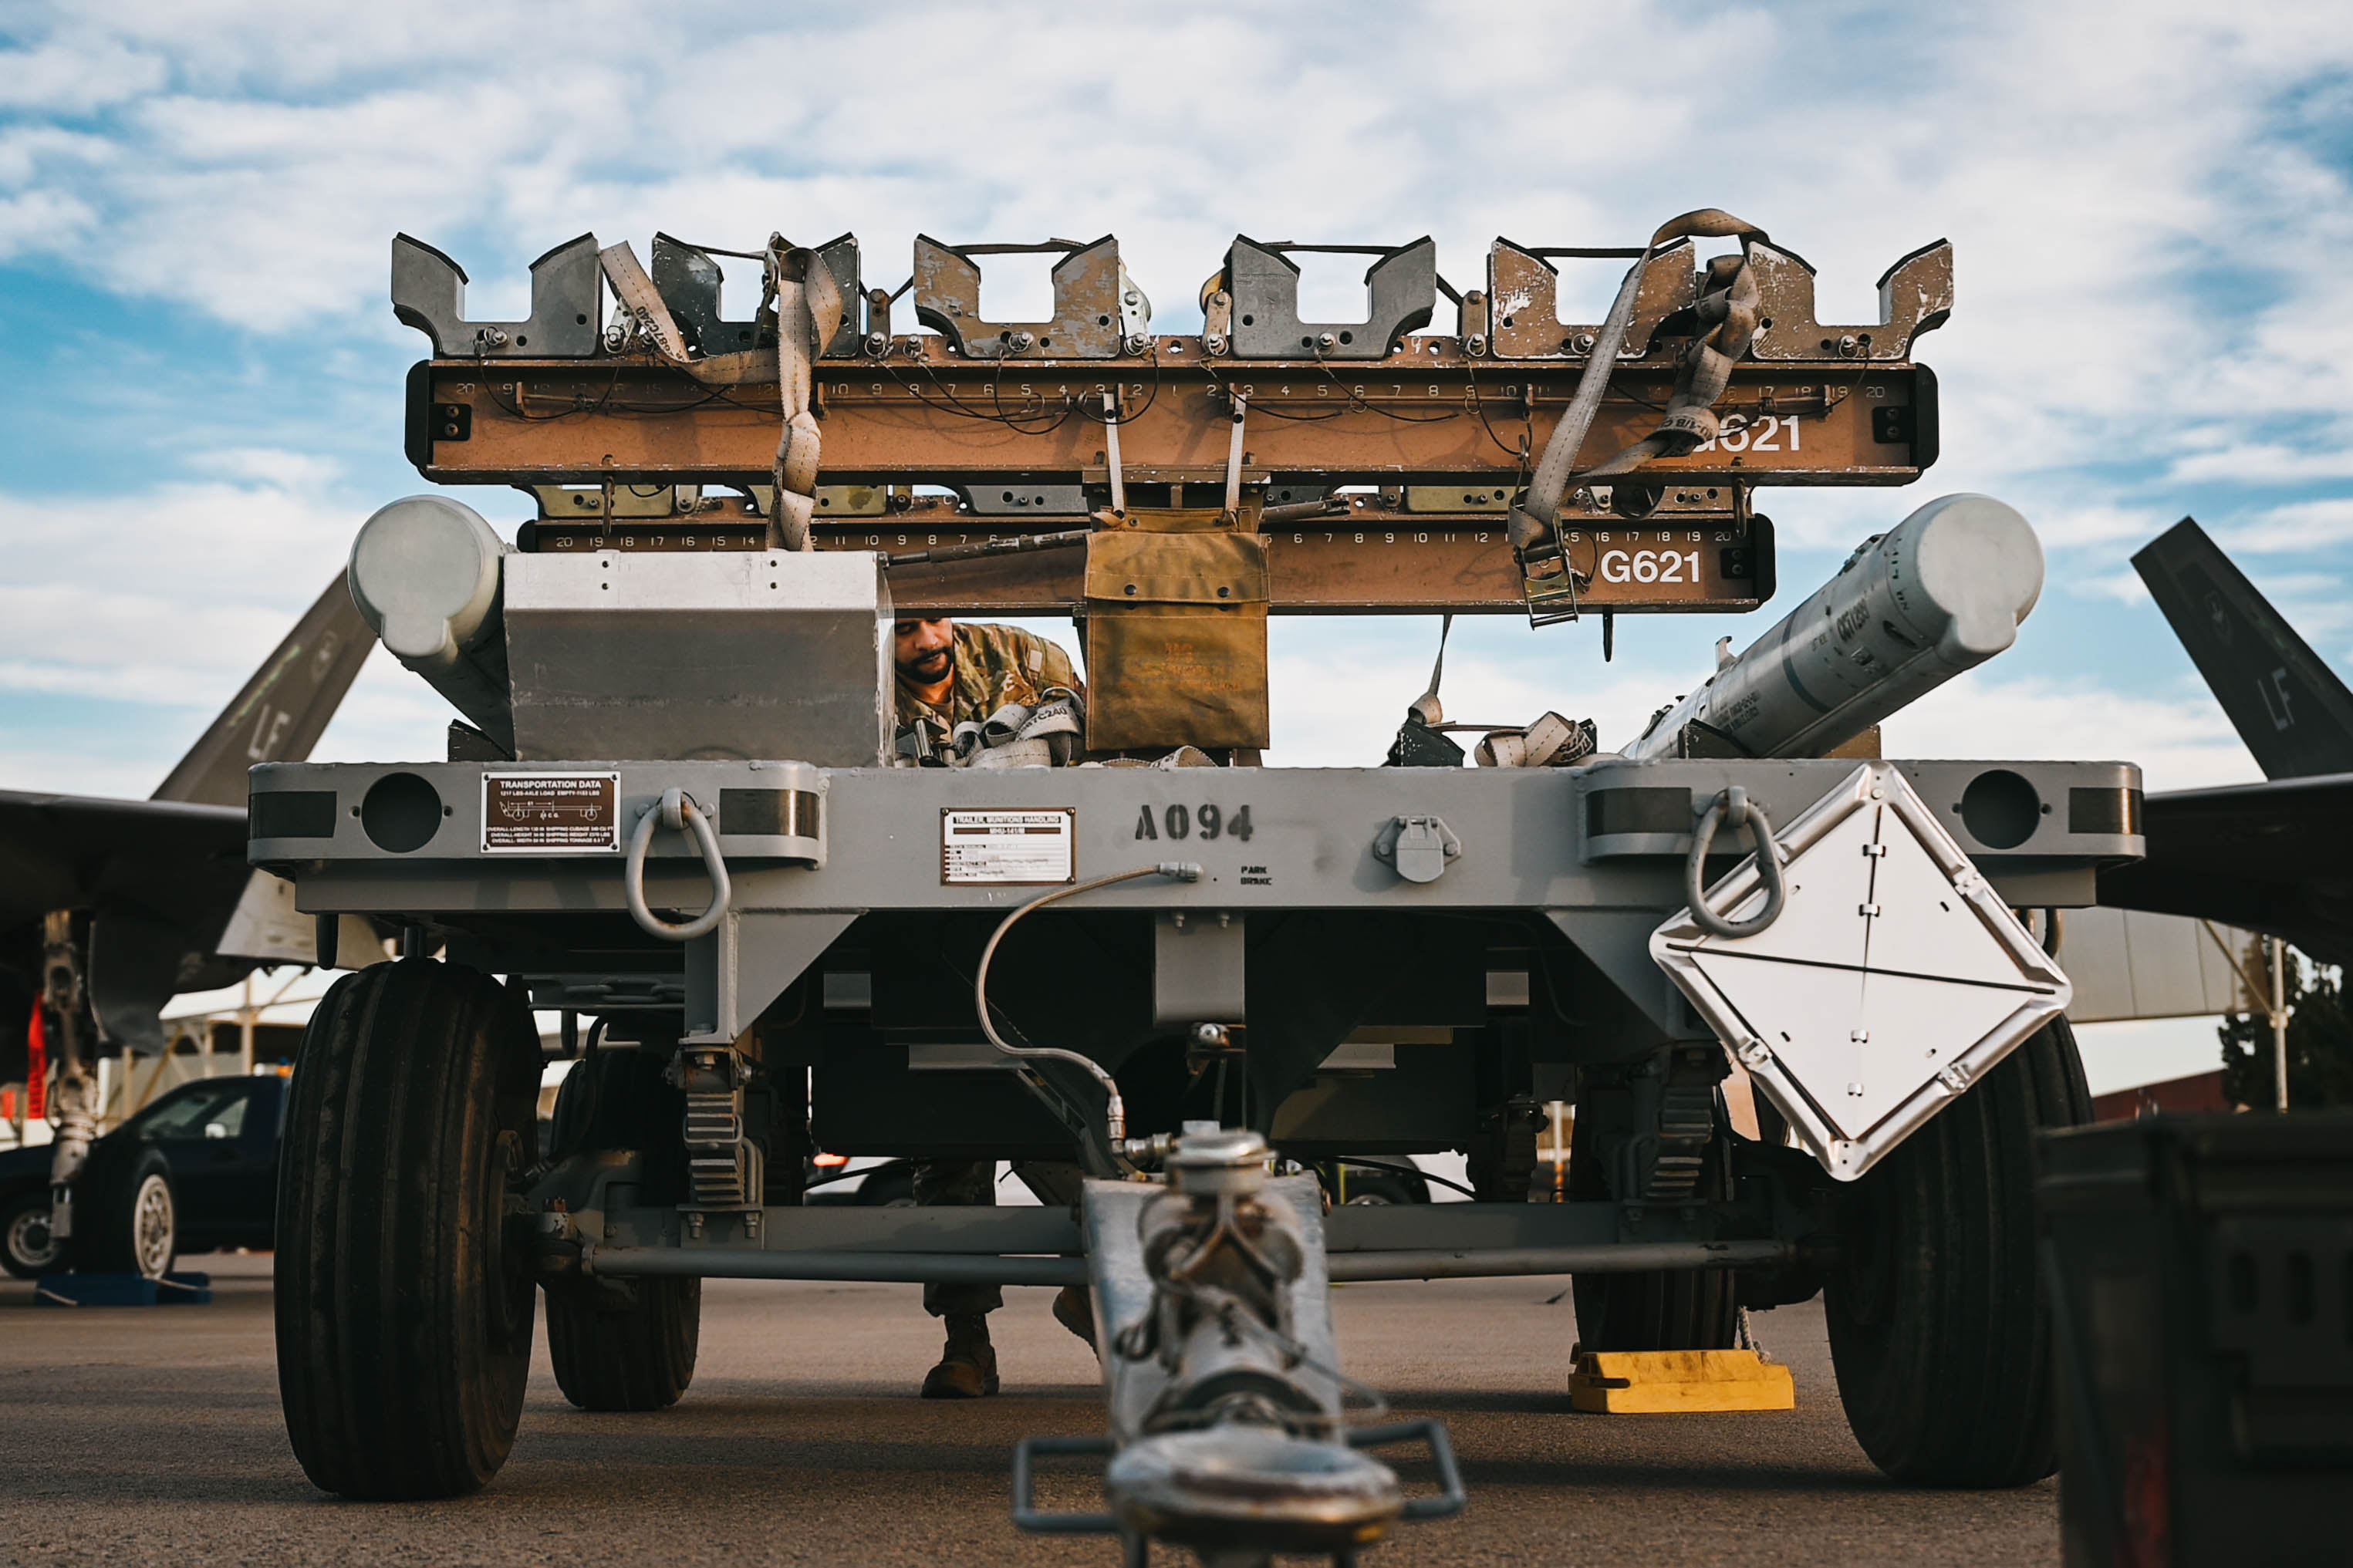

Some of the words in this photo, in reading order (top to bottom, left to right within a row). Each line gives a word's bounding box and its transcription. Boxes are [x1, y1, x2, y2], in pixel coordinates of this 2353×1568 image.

[456, 383, 475, 395] 20
[832, 383, 849, 395] 10
[872, 384, 883, 395] 9
[947, 384, 957, 395] 7
[984, 384, 994, 395] 6
[1021, 384, 1031, 395] 5
[1058, 385, 1068, 395] 4
[1095, 384, 1106, 395] 3
[1133, 385, 1143, 396] 2
[1206, 385, 1217, 396] 2
[1243, 385, 1254, 396] 3
[1281, 385, 1290, 396] 4
[1317, 385, 1328, 396] 5
[1354, 385, 1365, 396] 6
[1392, 385, 1402, 396] 7
[1428, 385, 1440, 396] 8
[1501, 385, 1517, 396] 10
[1758, 386, 1774, 397] 17
[1795, 386, 1811, 397] 18
[1831, 386, 1848, 397] 19
[1865, 386, 1885, 398] 20
[1692, 414, 1801, 453] 621
[556, 537, 573, 548] 20
[589, 537, 604, 547] 19
[620, 537, 634, 547] 18
[650, 537, 664, 547] 17
[681, 537, 696, 546] 16
[712, 536, 726, 546] 15
[743, 536, 755, 546] 14
[836, 535, 846, 545] 11
[865, 534, 879, 545] 10
[898, 534, 906, 545] 9
[928, 534, 937, 545] 8
[960, 534, 967, 545] 7
[1294, 533, 1303, 544] 6
[1324, 533, 1332, 543] 7
[1354, 533, 1364, 543] 8
[1385, 533, 1395, 543] 9
[1413, 533, 1428, 543] 10
[1445, 533, 1455, 542] 11
[1474, 533, 1488, 543] 12
[1595, 532, 1610, 542] 16
[1626, 532, 1640, 542] 17
[1657, 531, 1671, 542] 18
[1687, 531, 1702, 542] 19
[1715, 531, 1732, 542] 20
[1601, 549, 1700, 583] G621
[2257, 666, 2295, 732] LF
[247, 703, 292, 761] LF
[499, 780, 578, 789] TRANSPORTATION
[579, 780, 602, 789] DATA
[1135, 804, 1254, 842] A094
[1240, 877, 1272, 885] BRAKE
[1241, 865, 1268, 875] PARK
